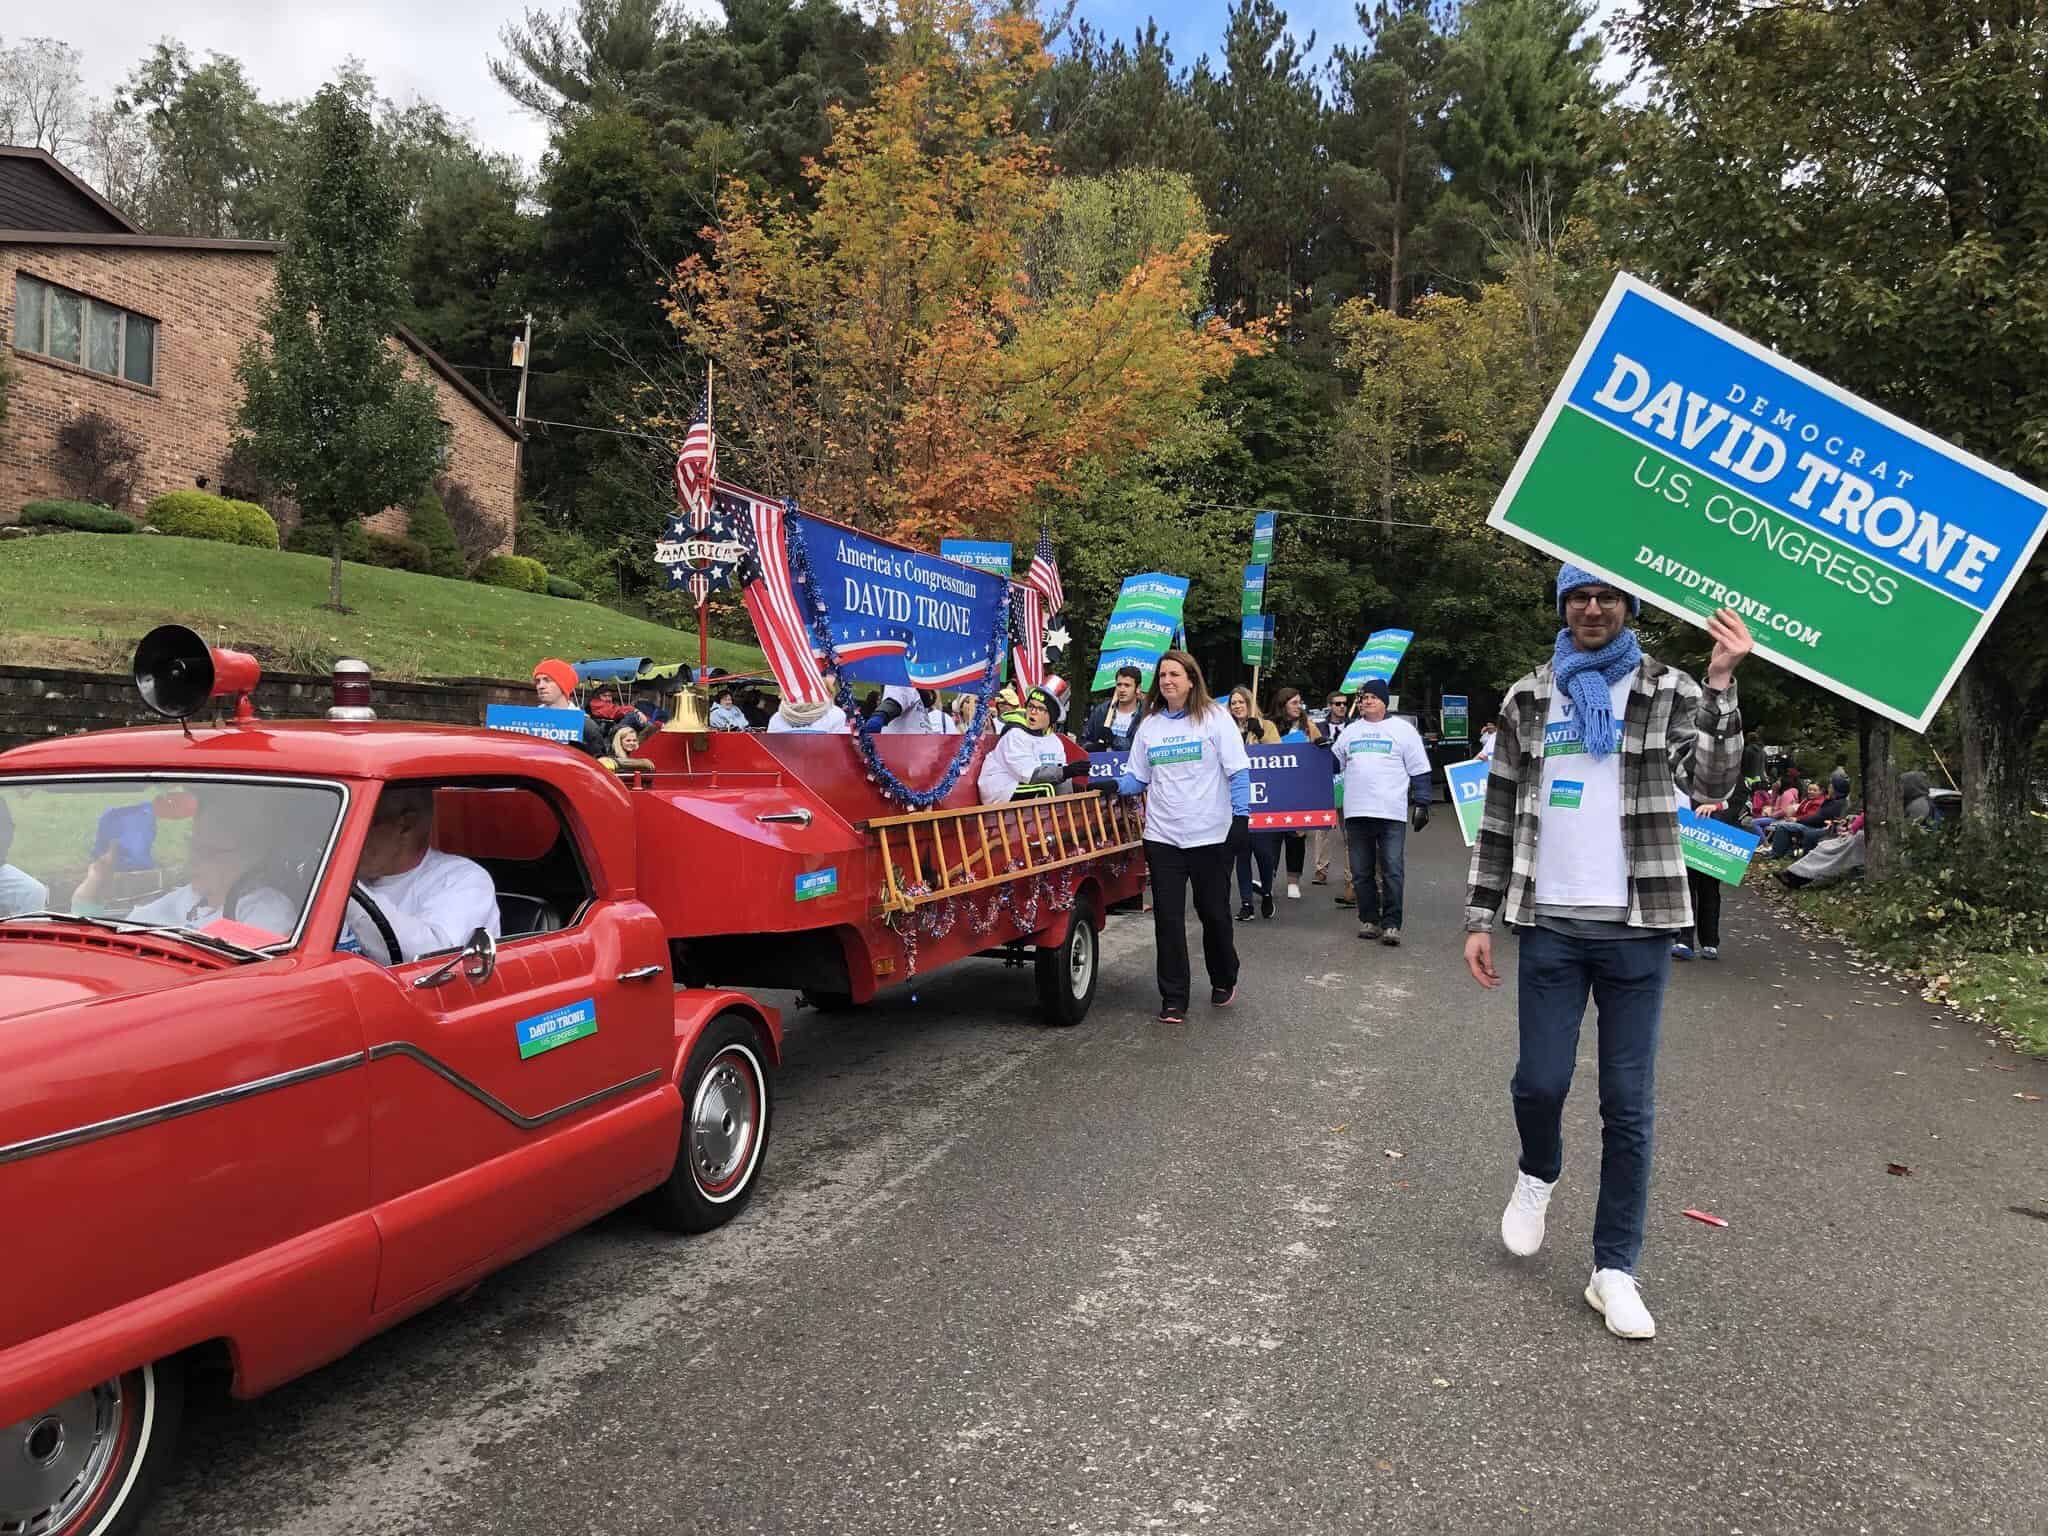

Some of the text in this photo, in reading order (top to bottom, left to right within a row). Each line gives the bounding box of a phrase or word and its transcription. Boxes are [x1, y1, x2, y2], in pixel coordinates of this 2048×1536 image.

[1725, 383, 1914, 489] DEMOCRAT
[1593, 353, 2000, 593] DAVID TRONE
[1632, 455, 1899, 606] U.S. CONGRESS
[660, 543, 733, 561] AMERICA
[975, 556, 1009, 566] TRONE
[836, 538, 977, 599] America's Congressman
[844, 577, 971, 636] DAVID TRONE
[1633, 545, 1823, 649] DAVIDTRONE.COM
[1126, 658, 1154, 671] TRON
[531, 727, 580, 741] TRONE
[1544, 729, 1579, 744] AVID
[1711, 836, 1751, 860] TRONE
[528, 1009, 586, 1039] DAVID TRONE
